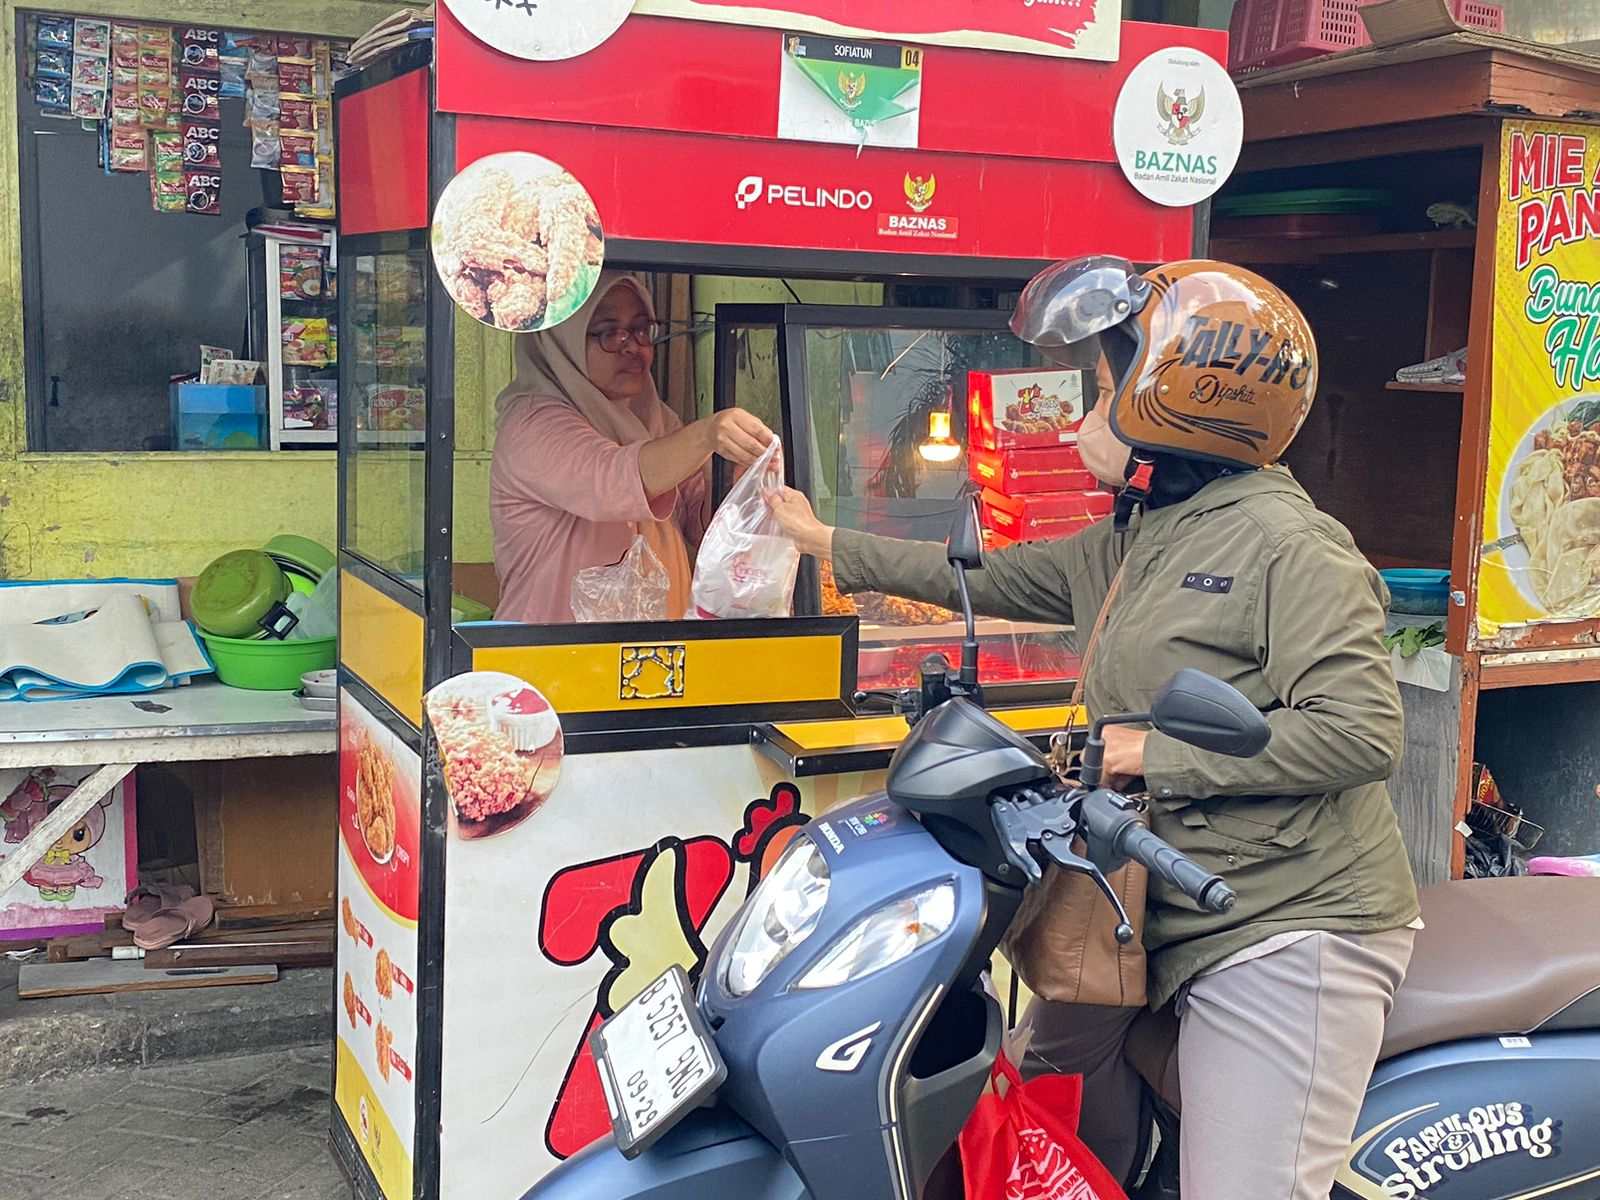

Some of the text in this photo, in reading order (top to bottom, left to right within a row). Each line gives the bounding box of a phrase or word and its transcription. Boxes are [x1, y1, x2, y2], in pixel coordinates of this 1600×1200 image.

[184, 28, 218, 42] ABC
[834, 45, 919, 67] SOFIATUN 04
[185, 77, 219, 91] ABC
[186, 126, 219, 139] ABC
[1135, 150, 1217, 175] BAZNAS
[1509, 133, 1586, 200] MIE
[189, 175, 220, 187] ABC
[1134, 172, 1154, 181] Badan
[1171, 174, 1188, 183] Zakat
[768, 185, 873, 210] PELINDO
[889, 215, 947, 231] BAZNAS
[646, 994, 687, 1050] 5257
